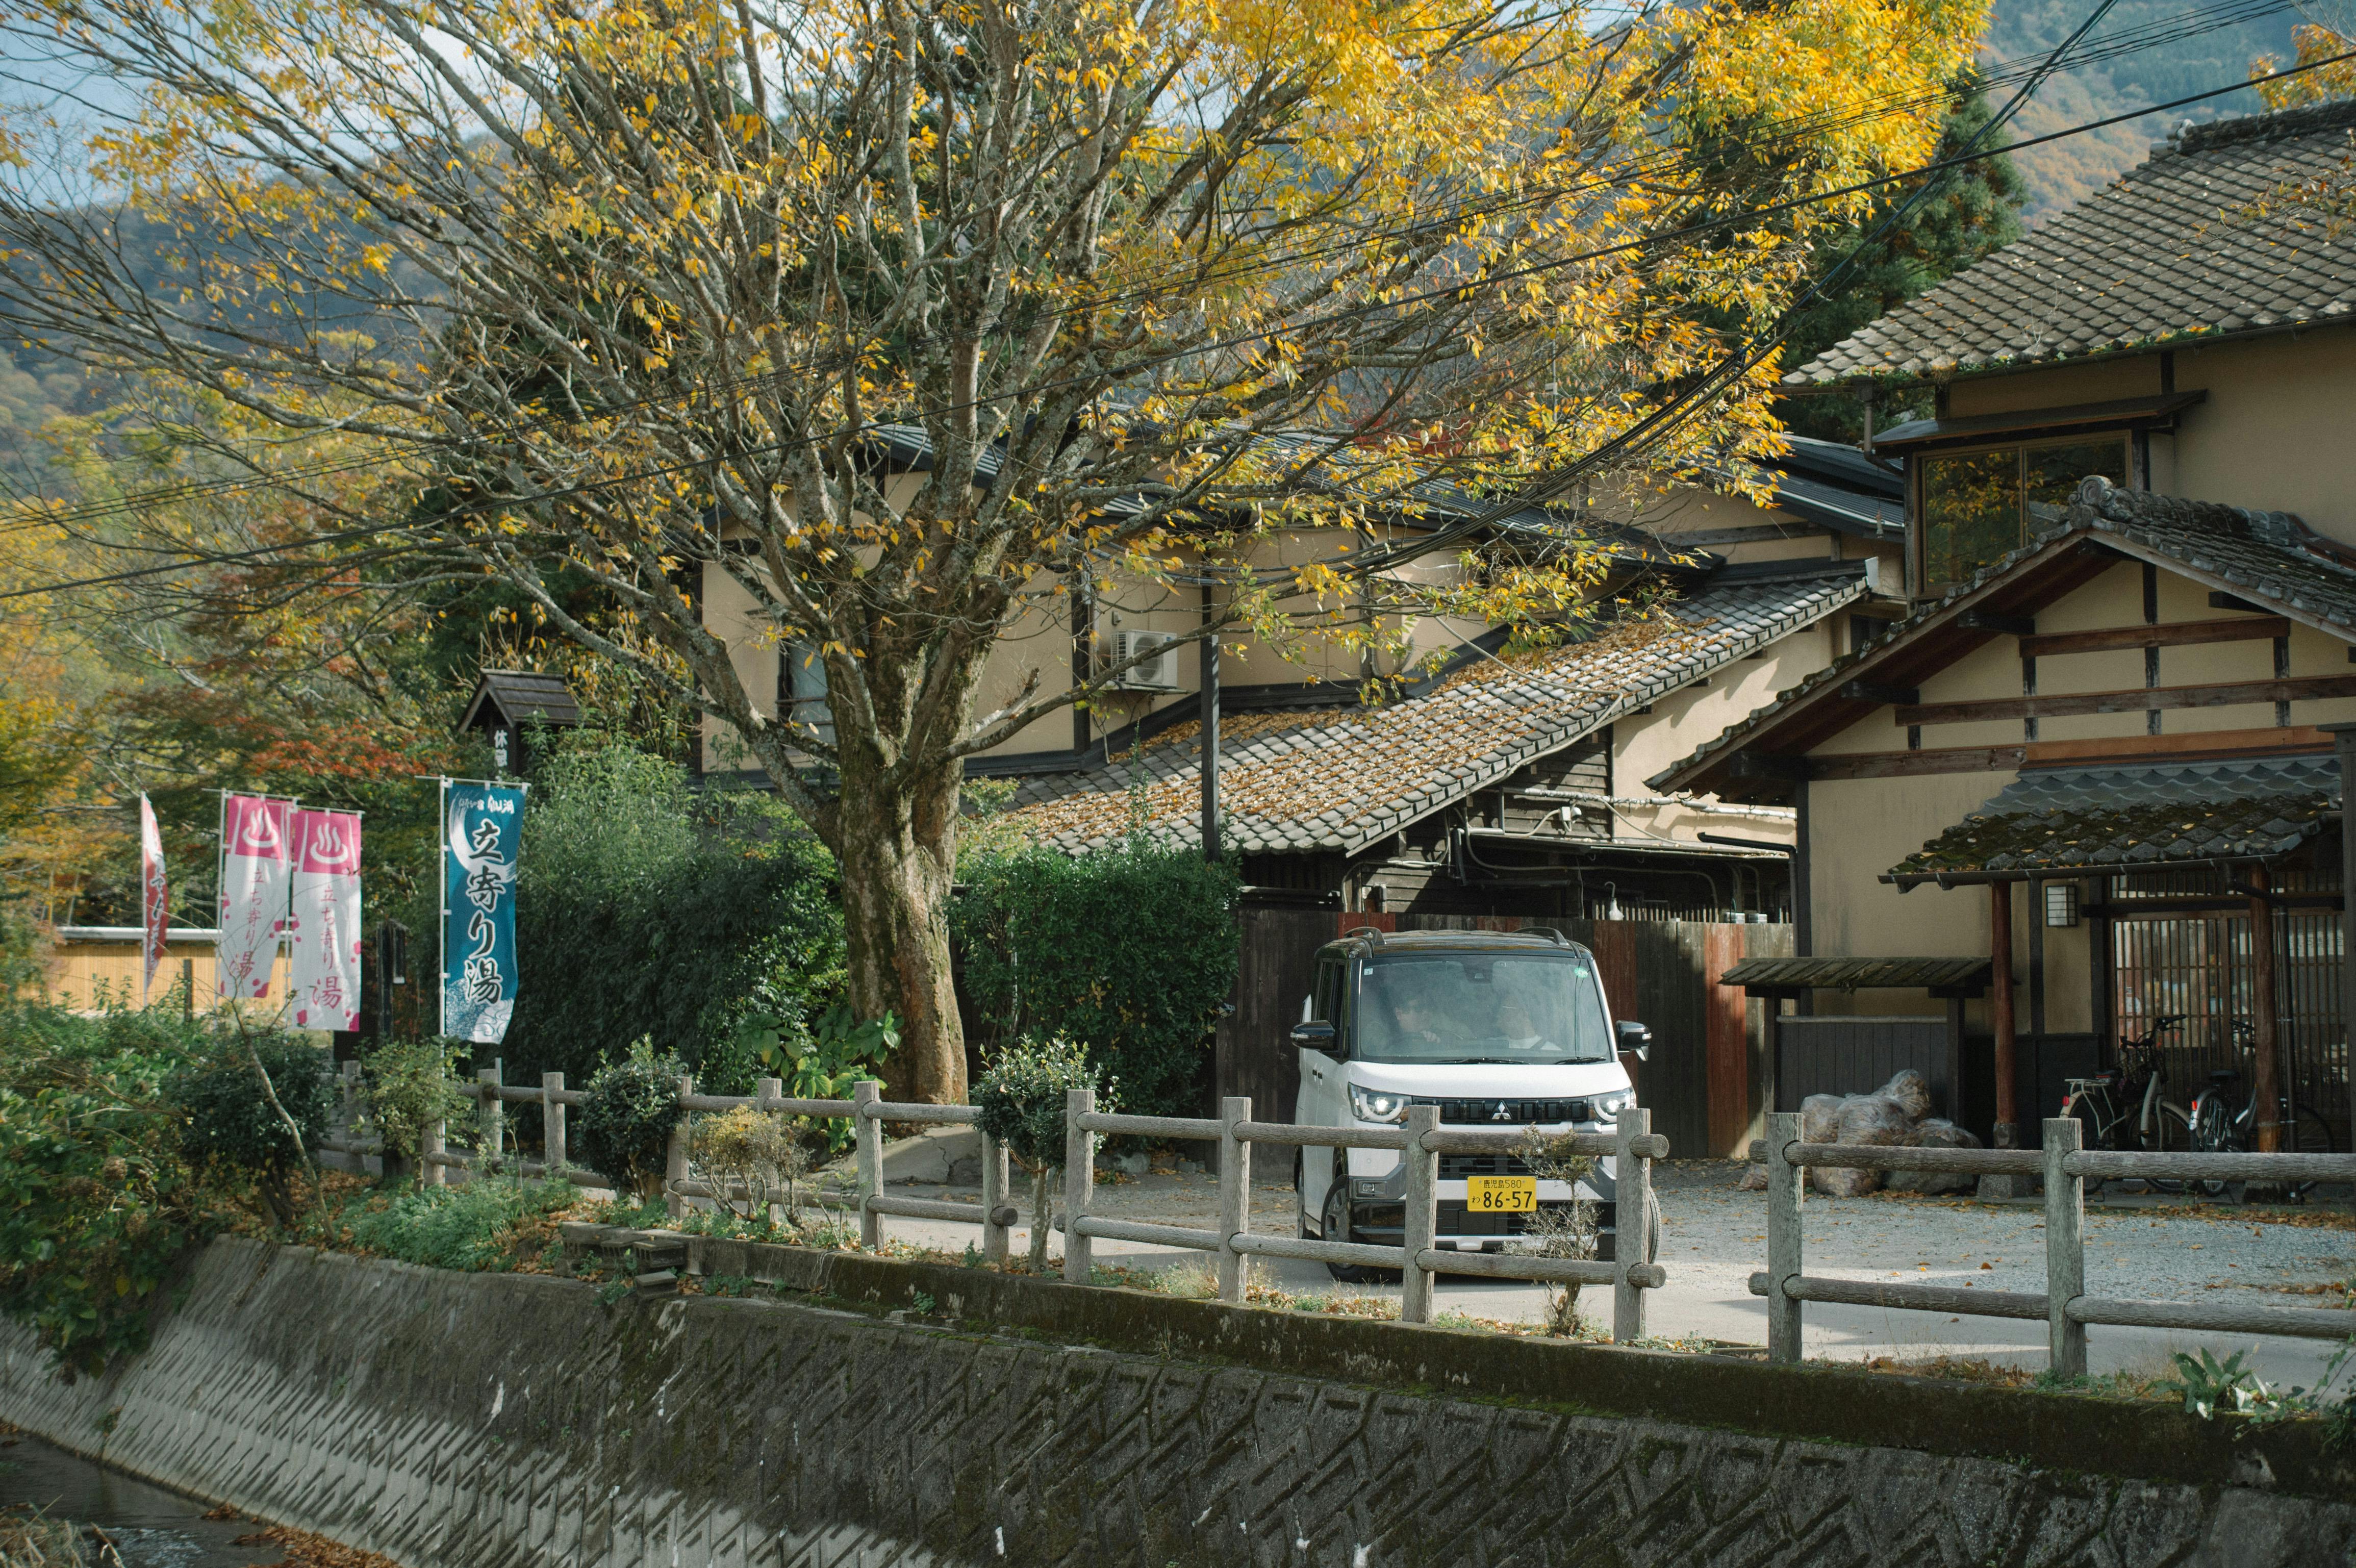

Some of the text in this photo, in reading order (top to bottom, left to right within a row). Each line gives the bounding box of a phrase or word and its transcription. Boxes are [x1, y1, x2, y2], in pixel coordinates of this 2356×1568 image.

[230, 868, 265, 979] 立ち寄り湯
[309, 884, 342, 1009] 立ち寄り湯
[465, 818, 505, 1004] 立寄り湯
[1483, 1191, 1532, 1208] 86-57
